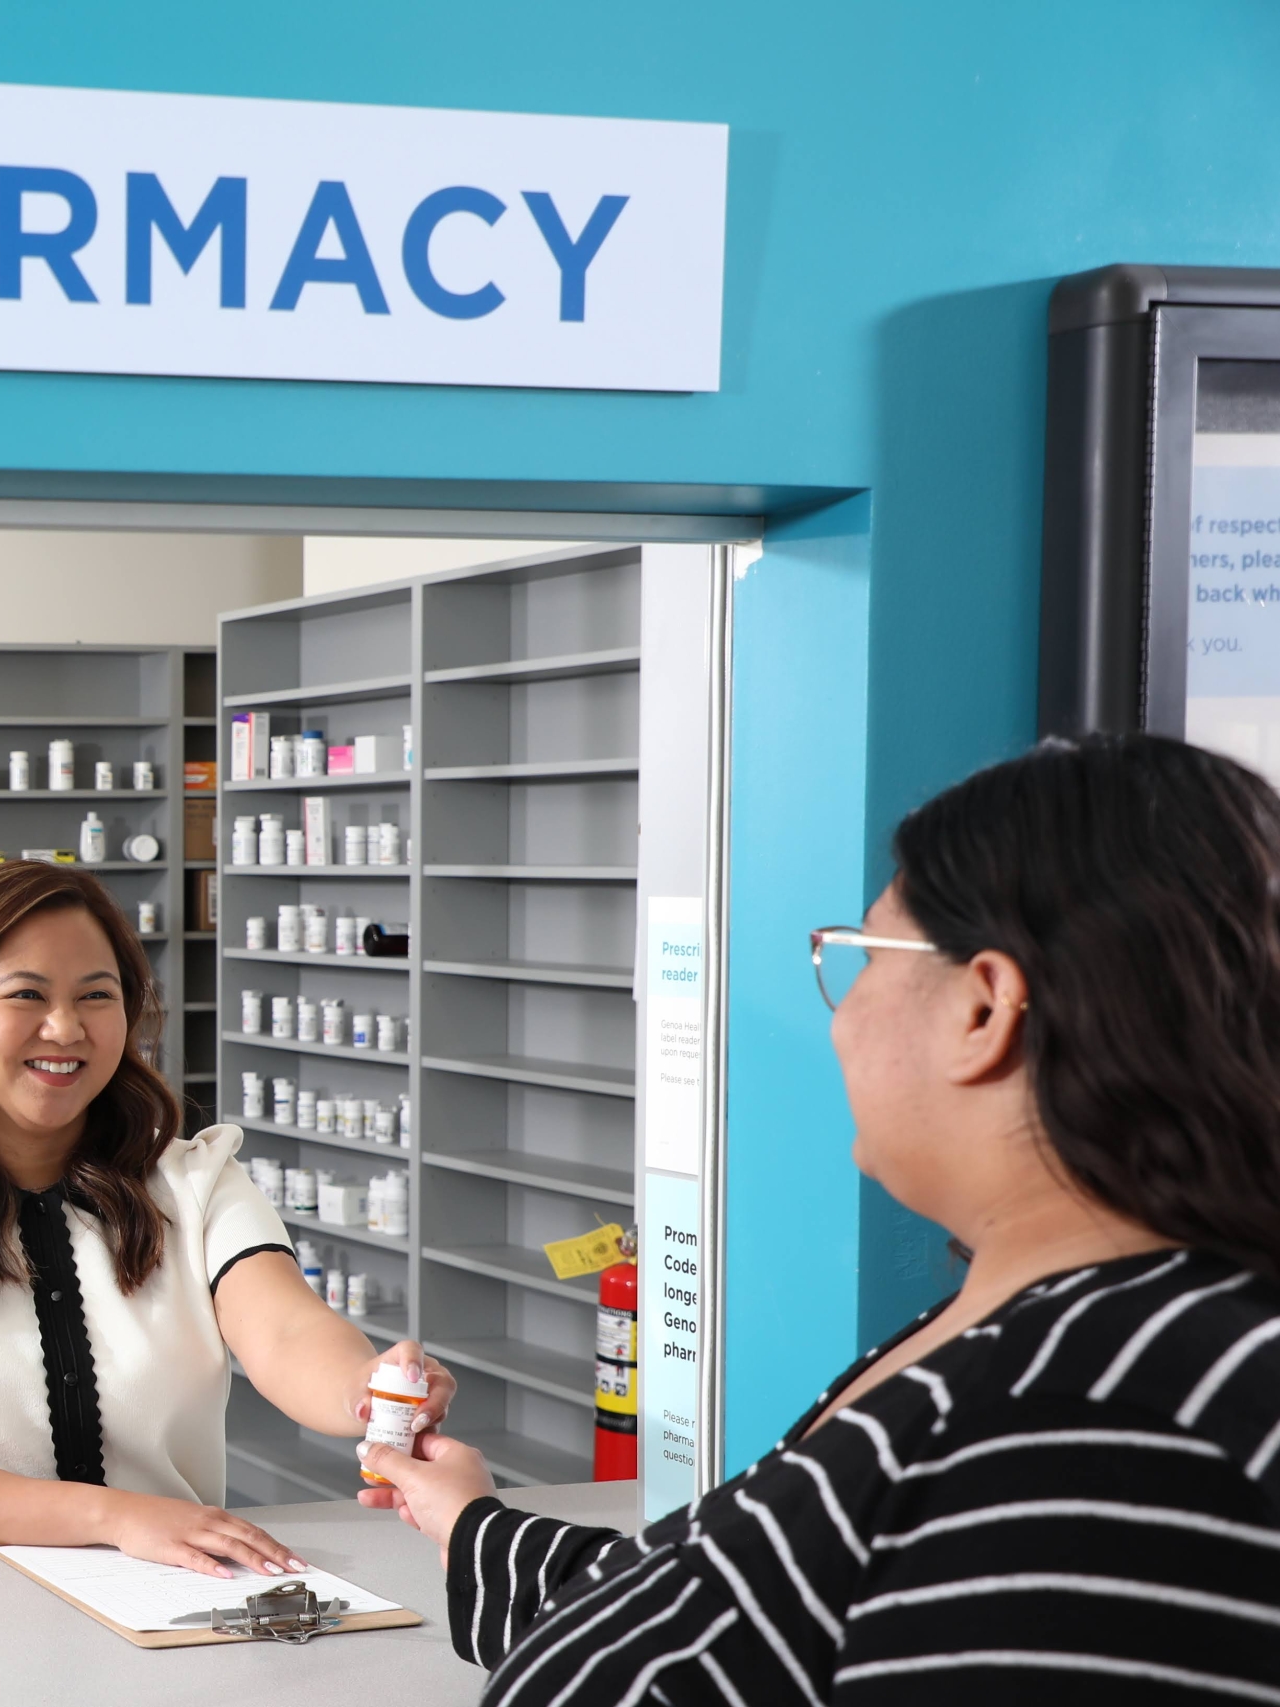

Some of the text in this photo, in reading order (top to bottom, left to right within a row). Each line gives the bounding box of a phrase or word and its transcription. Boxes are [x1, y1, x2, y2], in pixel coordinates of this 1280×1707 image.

[1197, 583, 1245, 602] back
[1202, 637, 1243, 656] you.
[662, 941, 702, 960] Prescri
[662, 967, 698, 982] reader
[661, 1019, 683, 1031] Genoa
[661, 1032, 700, 1045] label reader
[661, 1048, 701, 1060] upon reque
[661, 1072, 682, 1085] Please
[683, 1077, 696, 1086] see
[665, 1225, 697, 1247] Prom
[664, 1254, 697, 1276] Code
[664, 1311, 697, 1334] Geno
[663, 1409, 690, 1427] Please
[663, 1430, 695, 1448] pharma
[663, 1449, 696, 1467] questio
